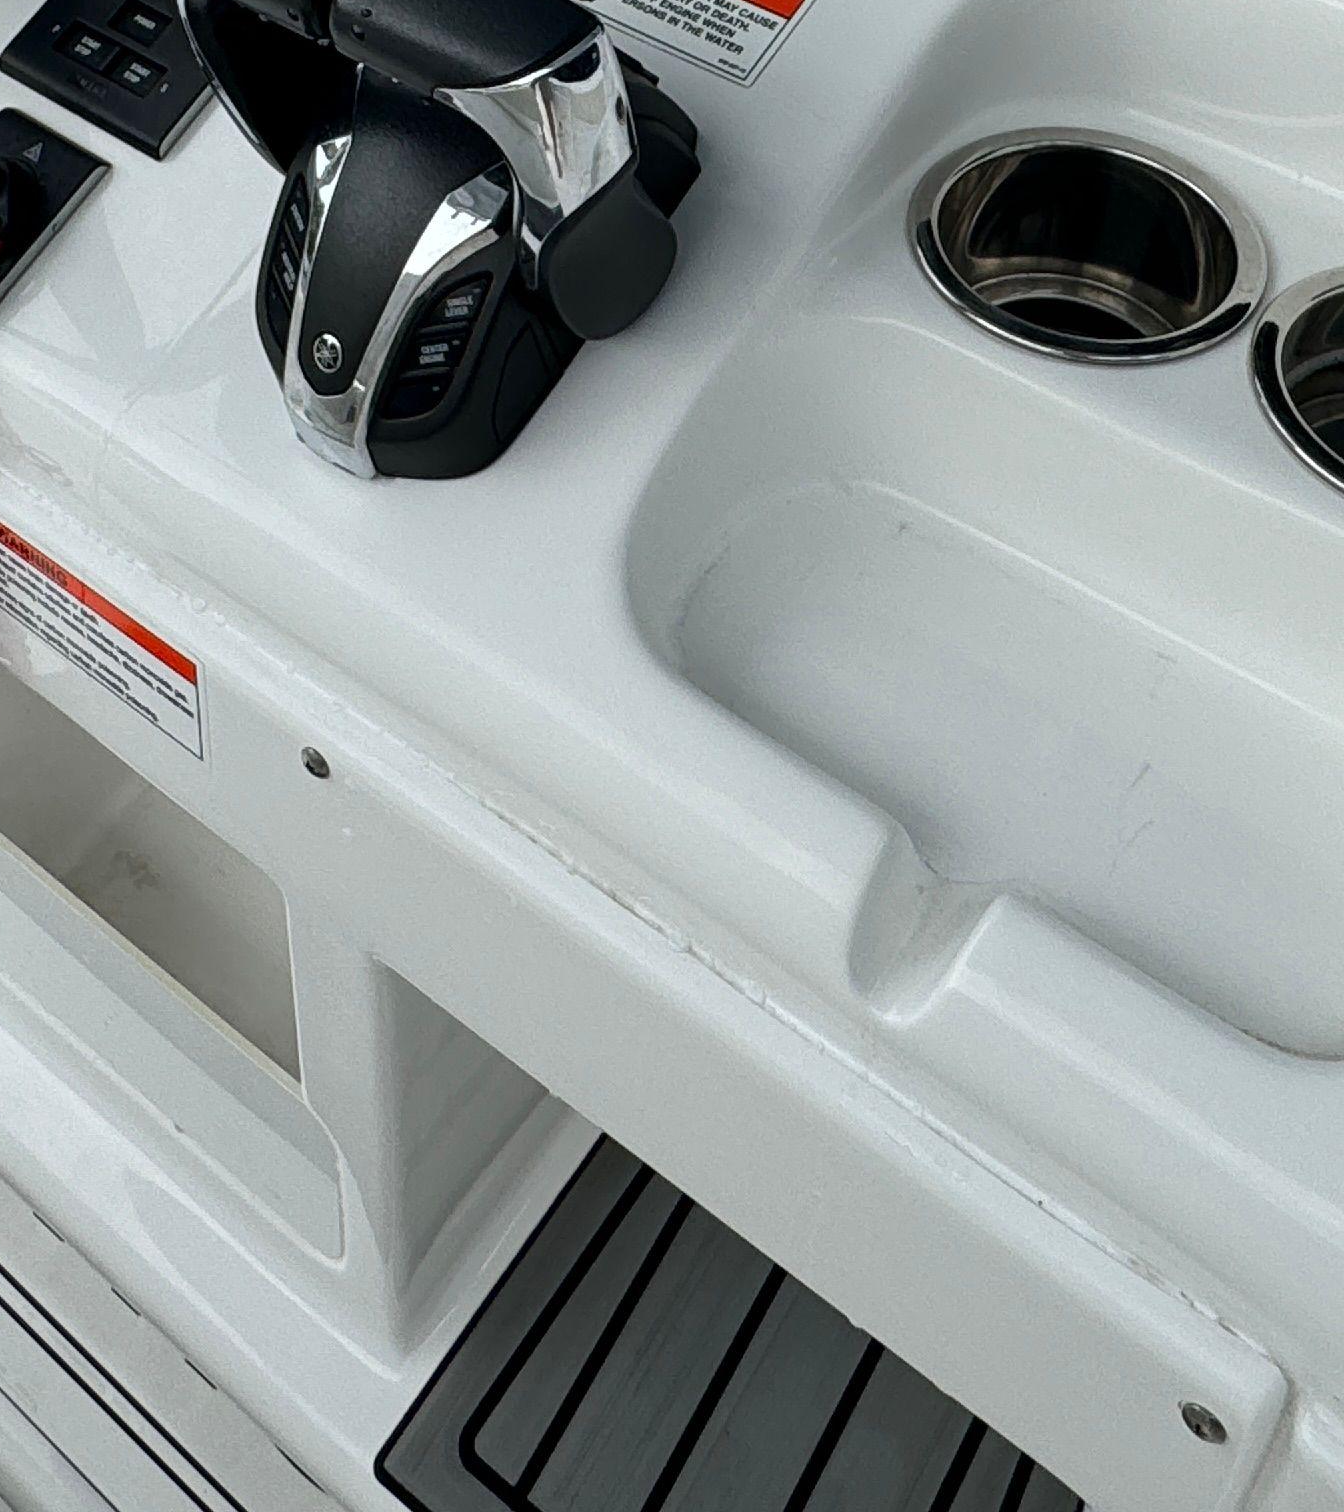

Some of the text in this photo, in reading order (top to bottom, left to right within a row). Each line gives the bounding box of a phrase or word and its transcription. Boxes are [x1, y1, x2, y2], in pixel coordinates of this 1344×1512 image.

[691, 0, 711, 13] OR
[700, 17, 737, 38] WHEN
[737, 7, 778, 30] CAUSE
[666, 15, 681, 27] IN
[680, 21, 704, 37] THE
[702, 31, 745, 55] WATER
